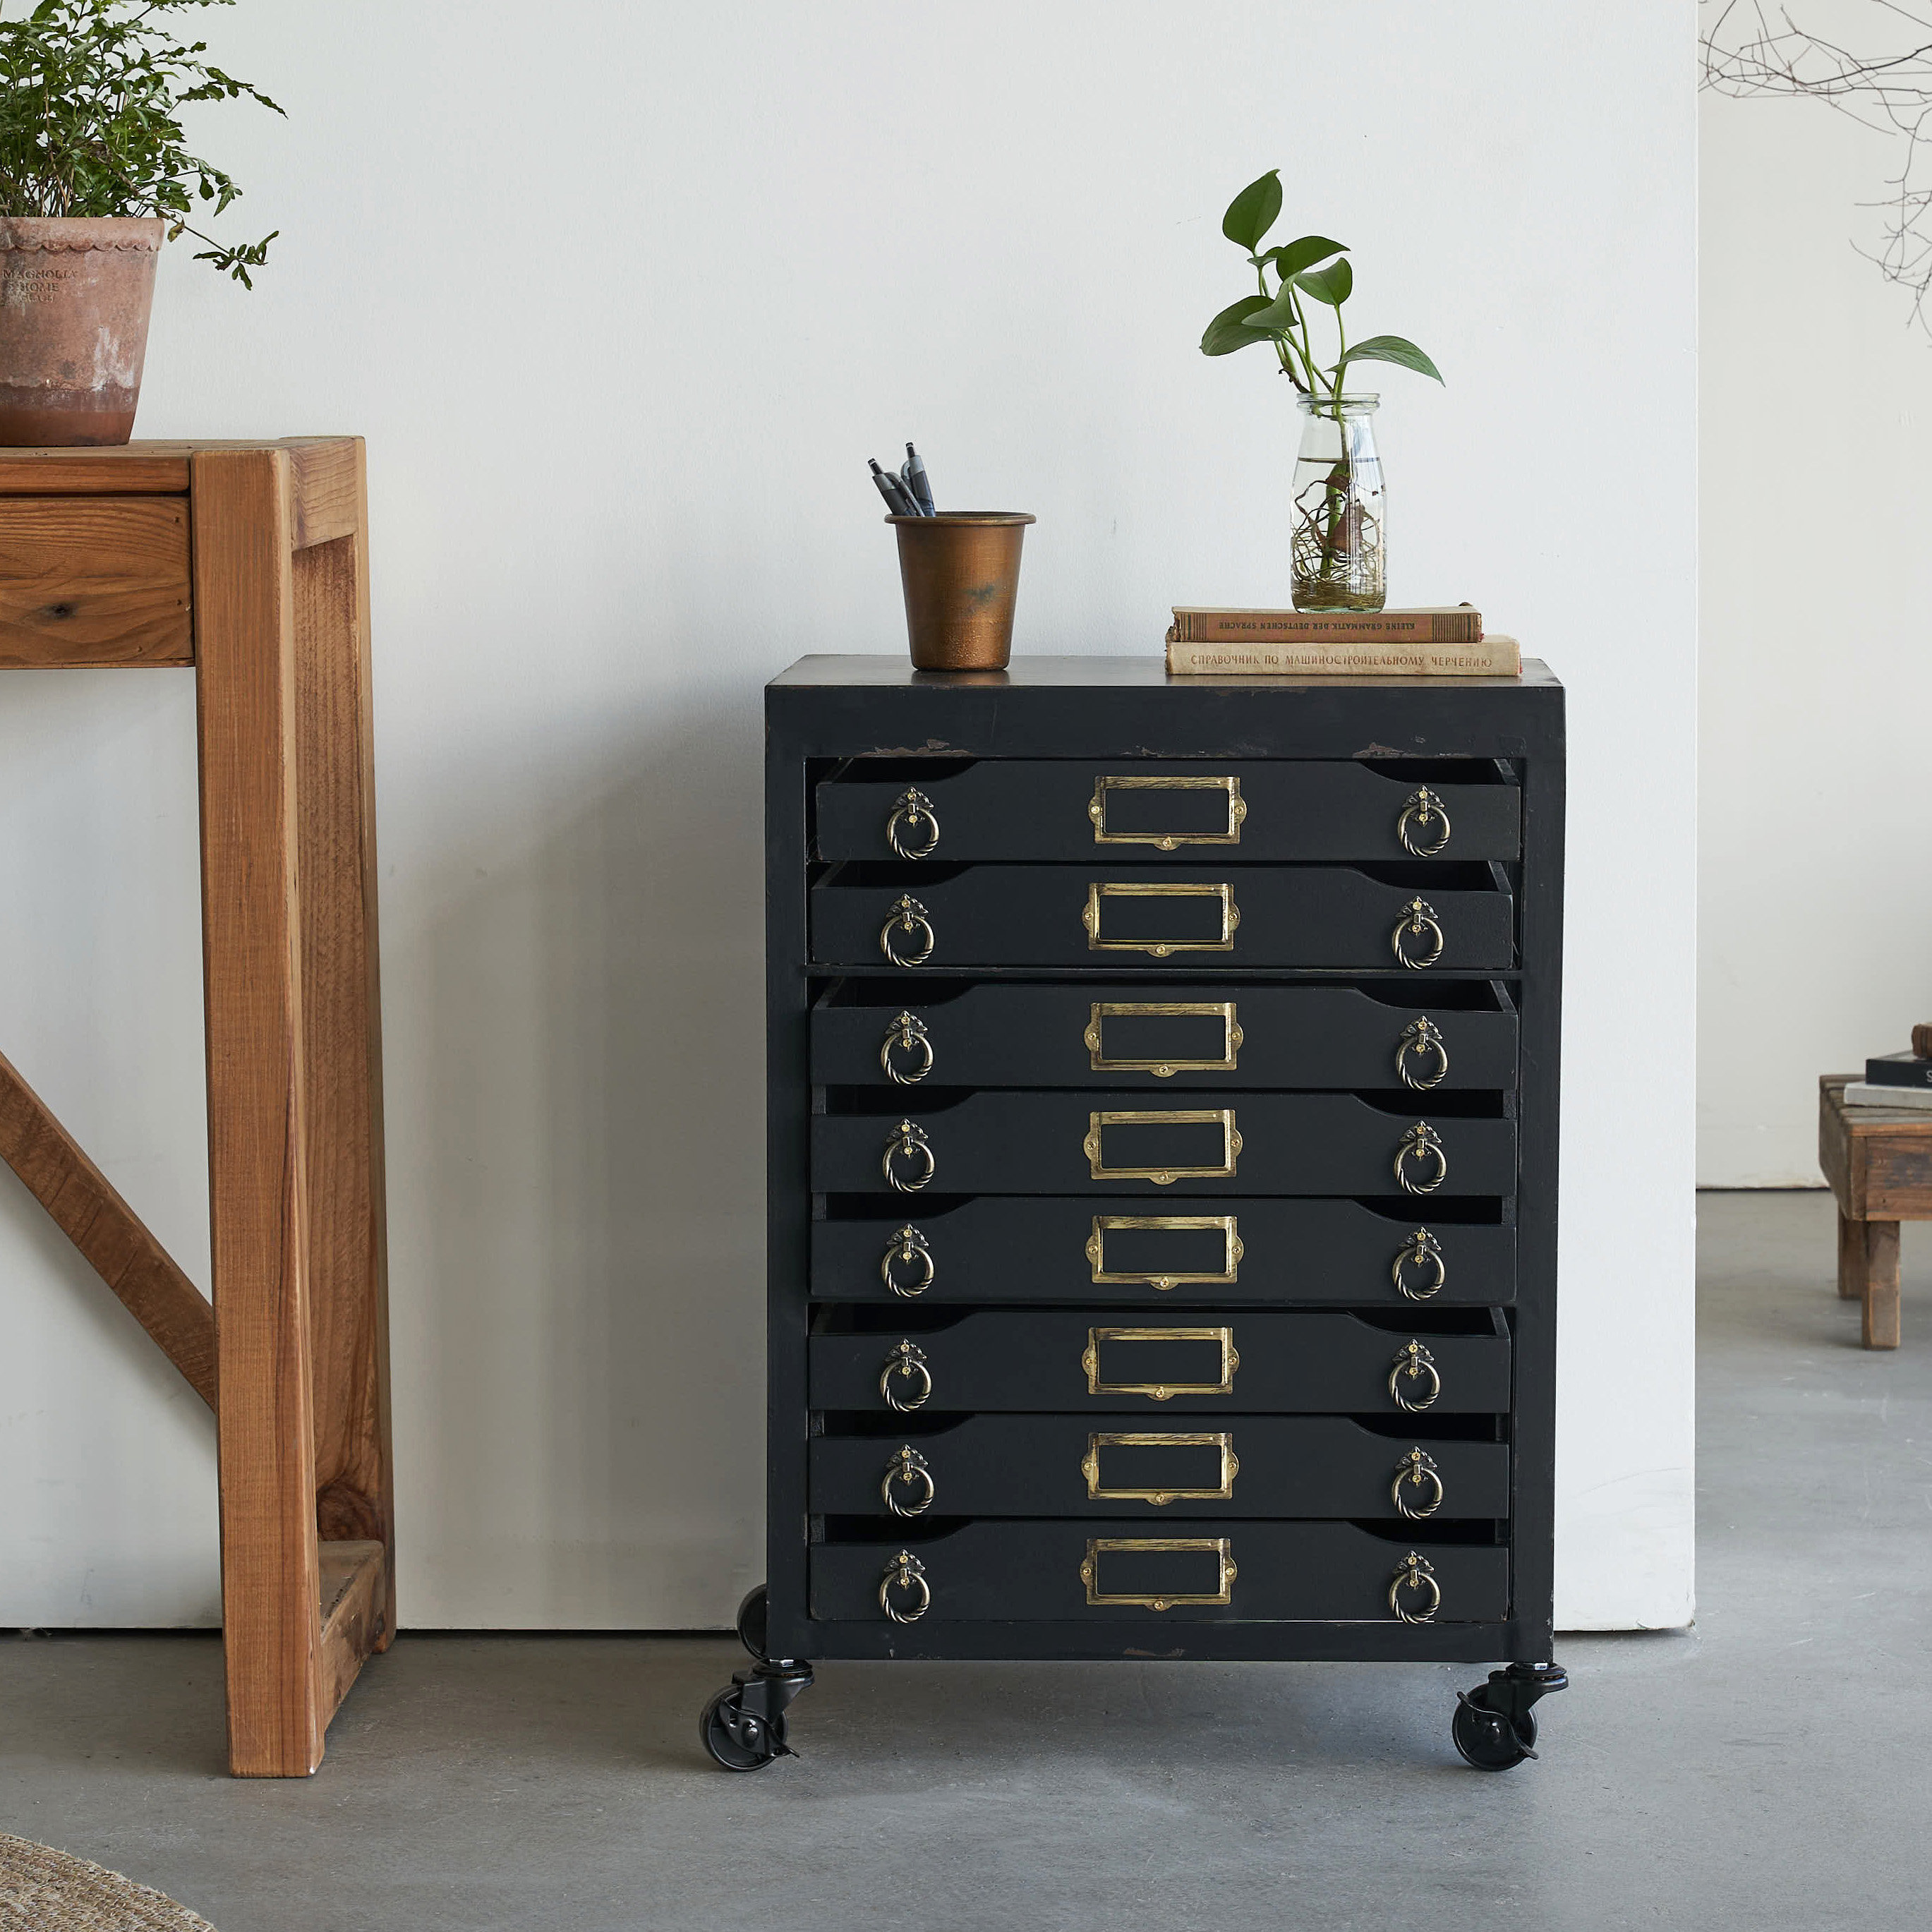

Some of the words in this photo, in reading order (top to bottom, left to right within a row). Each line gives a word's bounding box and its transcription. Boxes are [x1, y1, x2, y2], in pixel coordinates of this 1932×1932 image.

[1218, 622, 1257, 630] SPRACHE
[1190, 654, 1260, 665] СПРАВОЧНИК
[1264, 655, 1279, 665] ПО
[1285, 655, 1425, 666] МАШИНОСТРОИТЕЛЬНОМУ
[1431, 656, 1492, 668] ЧЕРЧЕНИЮ
